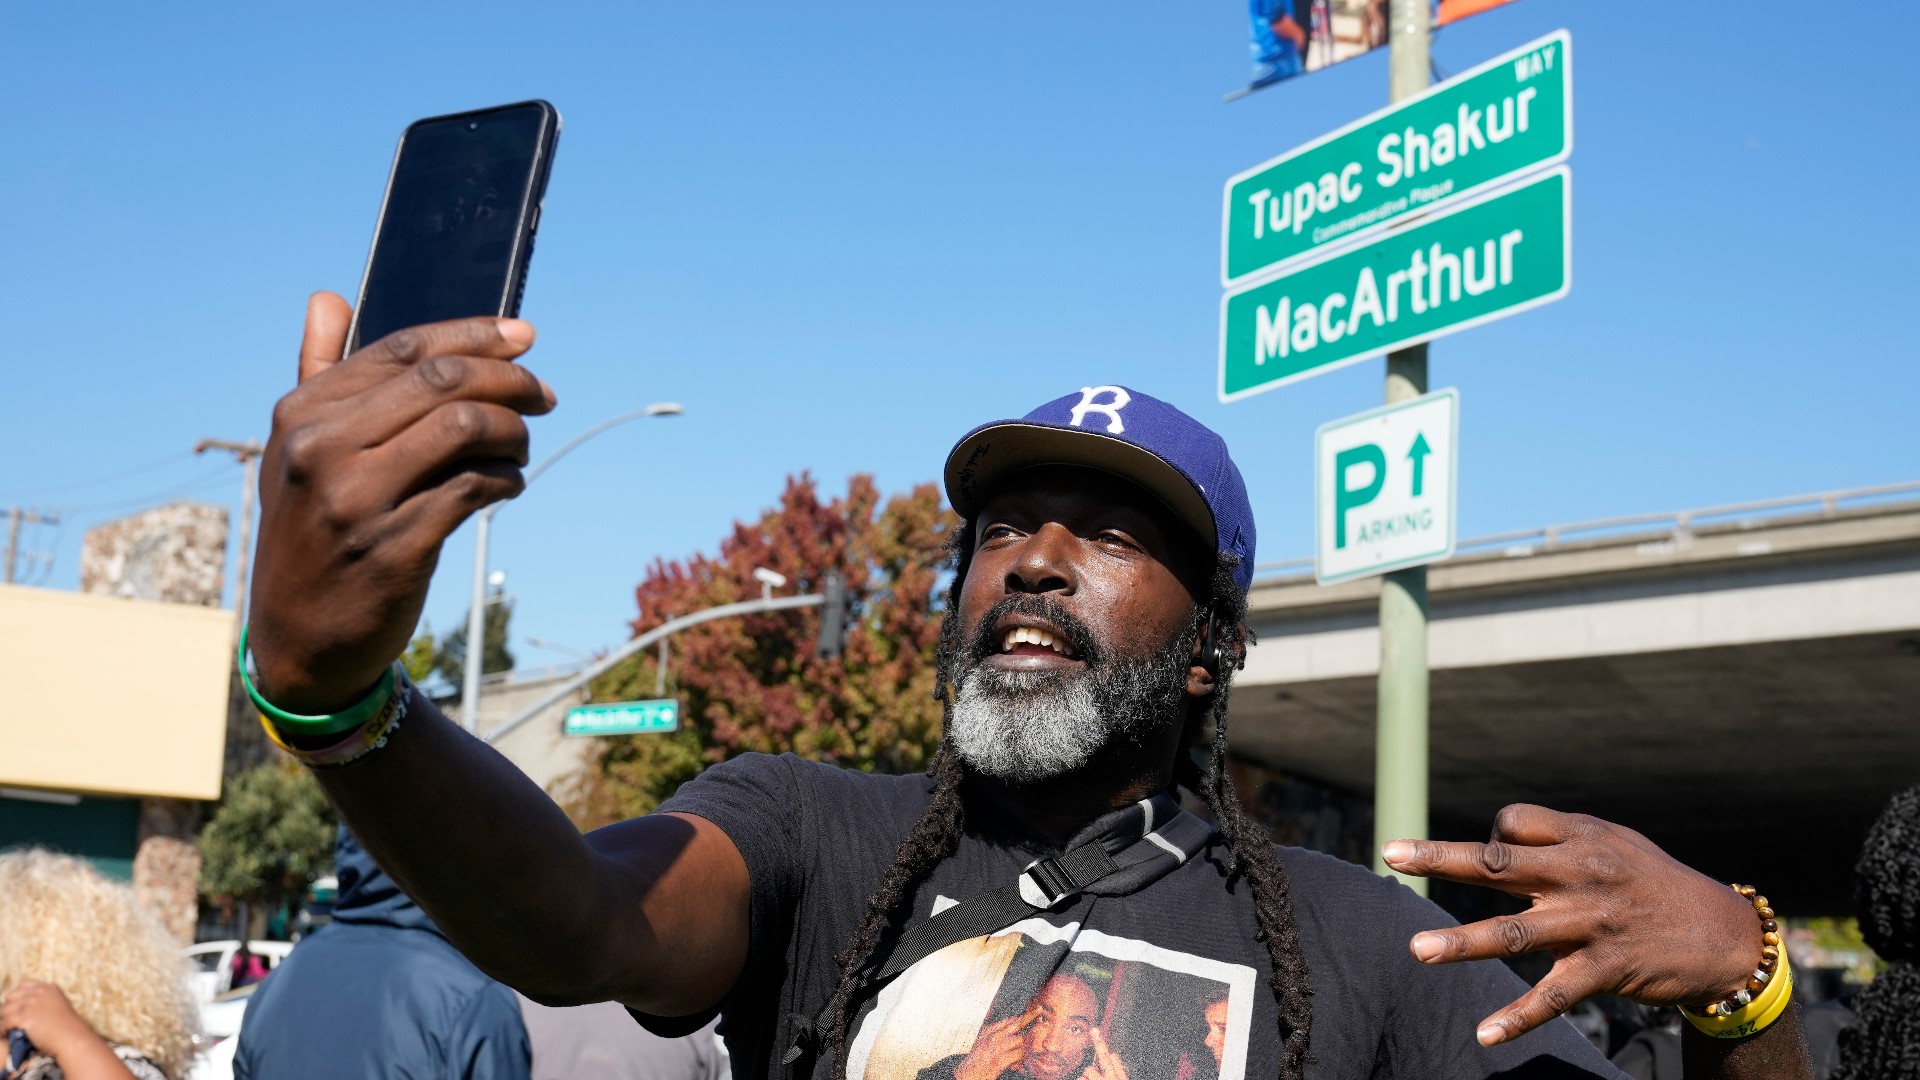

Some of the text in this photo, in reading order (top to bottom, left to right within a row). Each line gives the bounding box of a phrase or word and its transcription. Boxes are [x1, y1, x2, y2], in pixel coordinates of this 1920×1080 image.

[1514, 46, 1556, 84] WAY
[1248, 87, 1537, 239] Tupac Shakur
[1253, 229, 1524, 366] MacArthur
[1069, 385, 1132, 435] R
